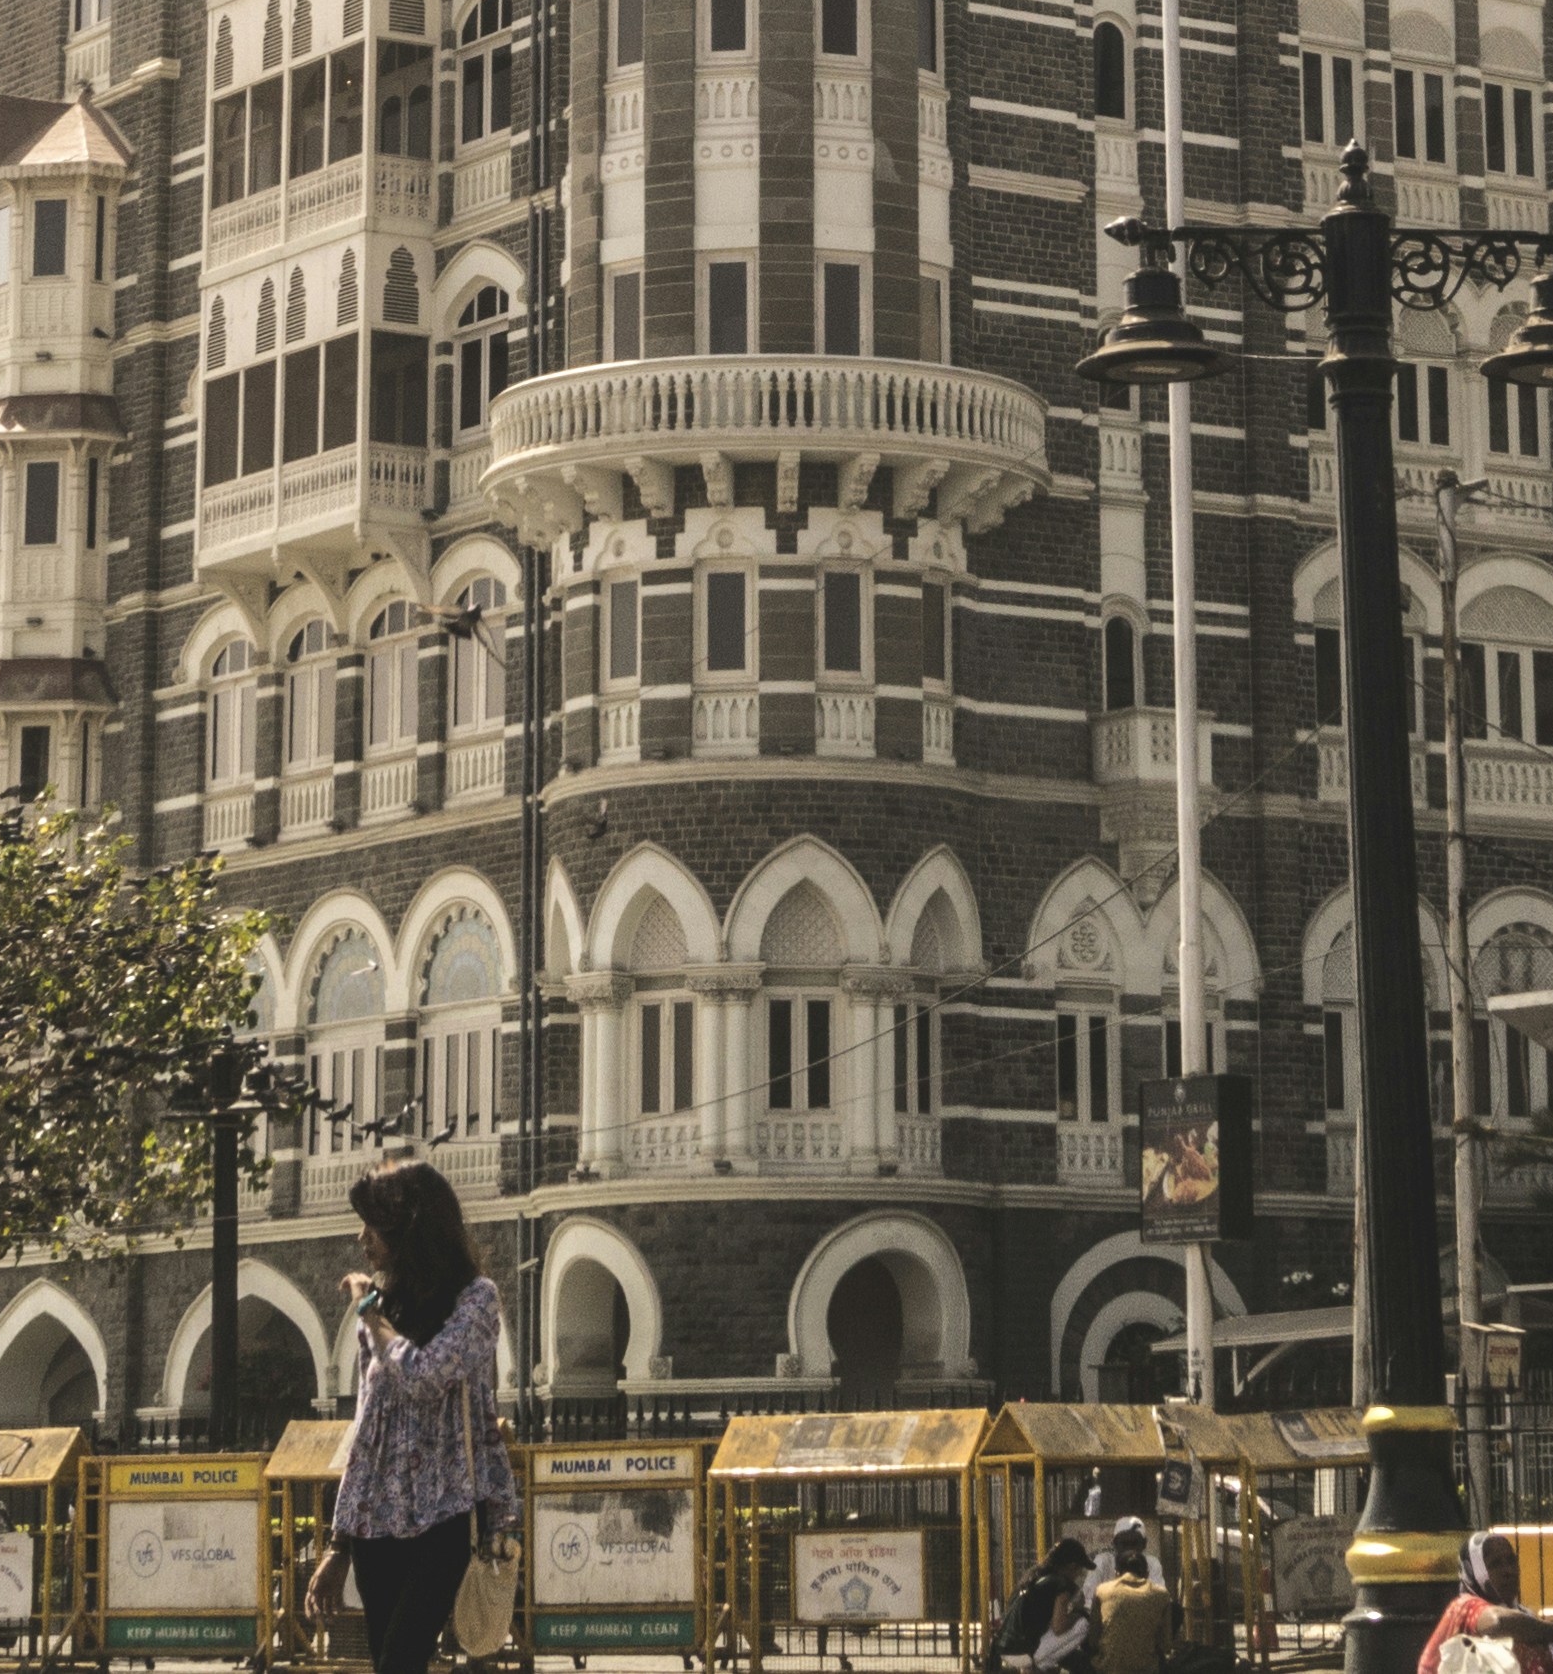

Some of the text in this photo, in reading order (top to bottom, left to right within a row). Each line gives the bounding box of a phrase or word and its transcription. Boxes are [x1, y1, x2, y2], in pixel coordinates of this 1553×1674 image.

[551, 1456, 676, 1474] MUMBAI POLICE
[130, 1470, 238, 1485] MUMBAI POLICE
[127, 1627, 236, 1639] KEEP MUMBAI CLEAN
[550, 1623, 679, 1637] KEEP MUMBAI CLEAN
